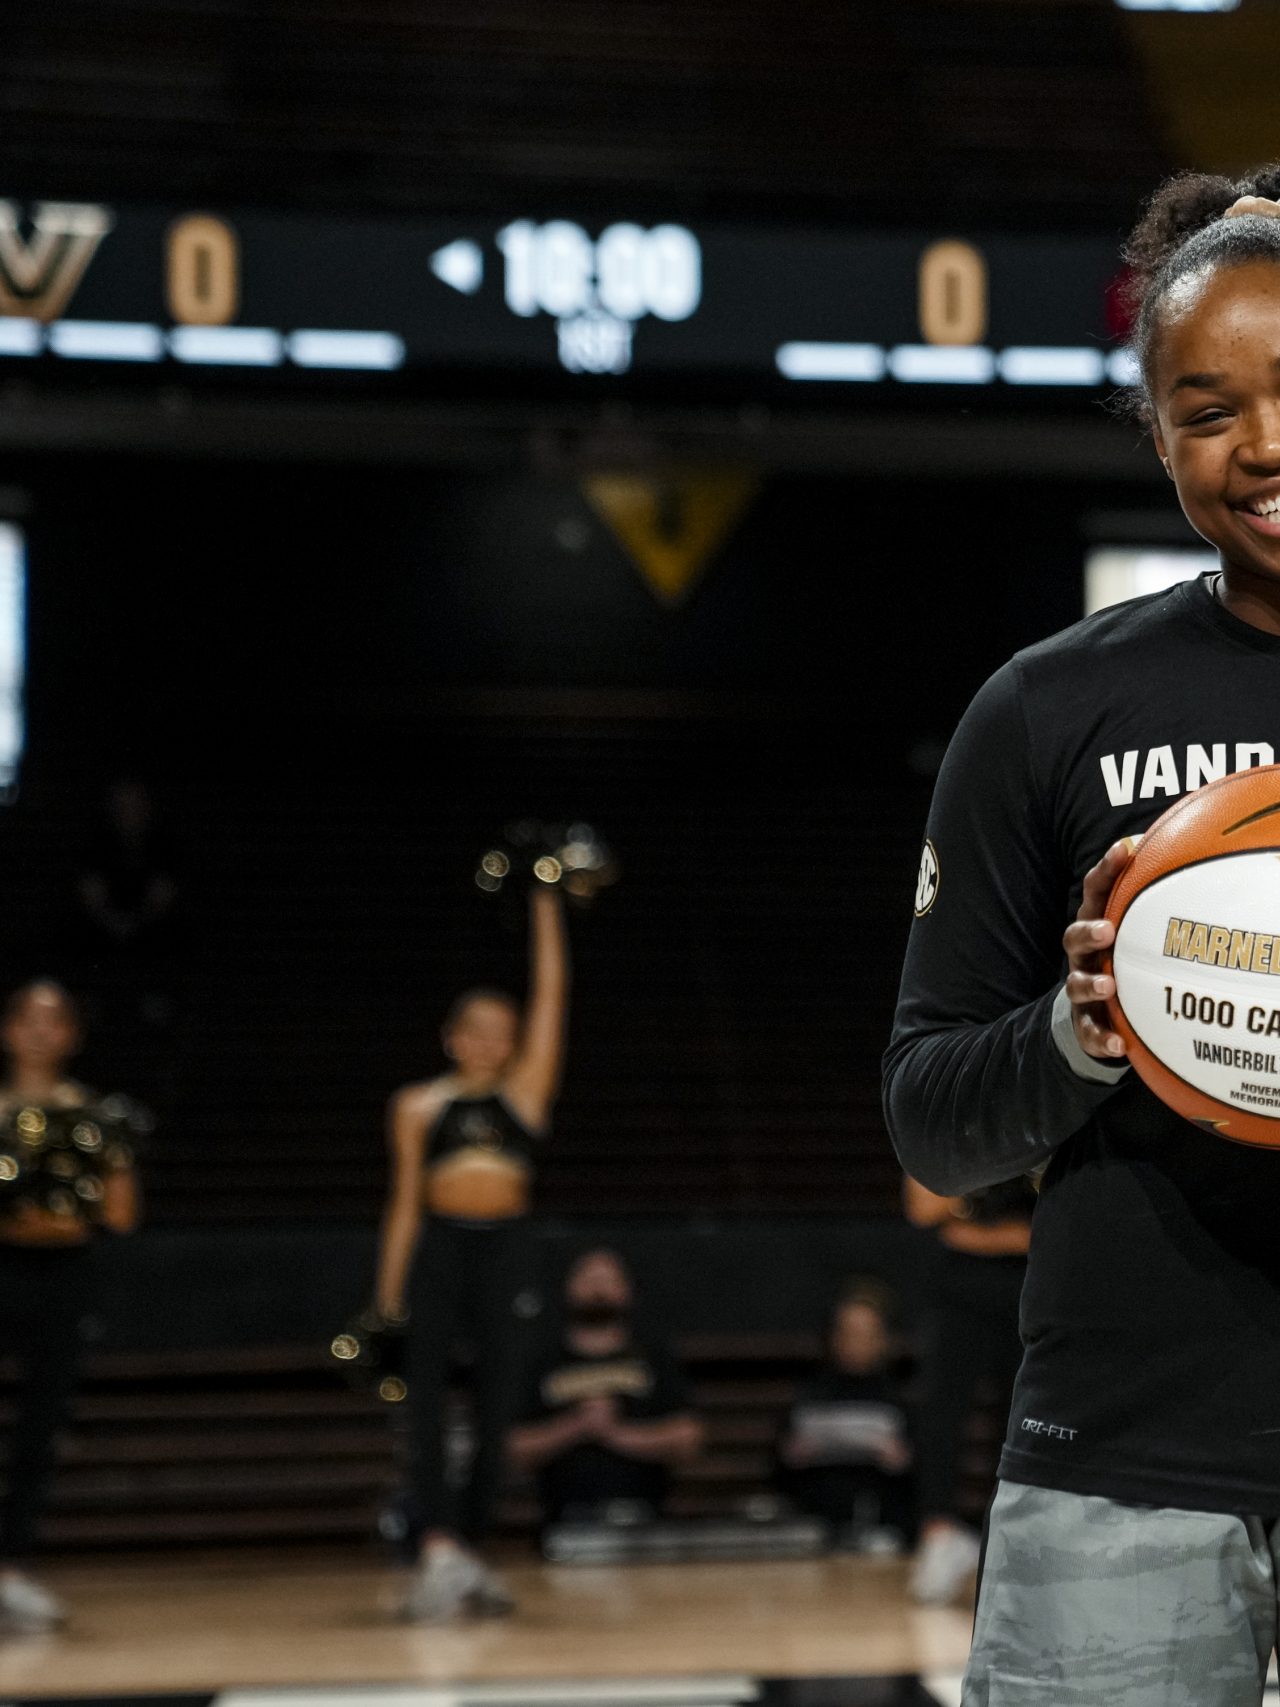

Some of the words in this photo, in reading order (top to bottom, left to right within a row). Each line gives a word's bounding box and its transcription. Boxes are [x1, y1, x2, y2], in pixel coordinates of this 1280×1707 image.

[166, 212, 239, 326] 0
[918, 238, 988, 346] 0
[1163, 986, 1235, 1029] 1,000
